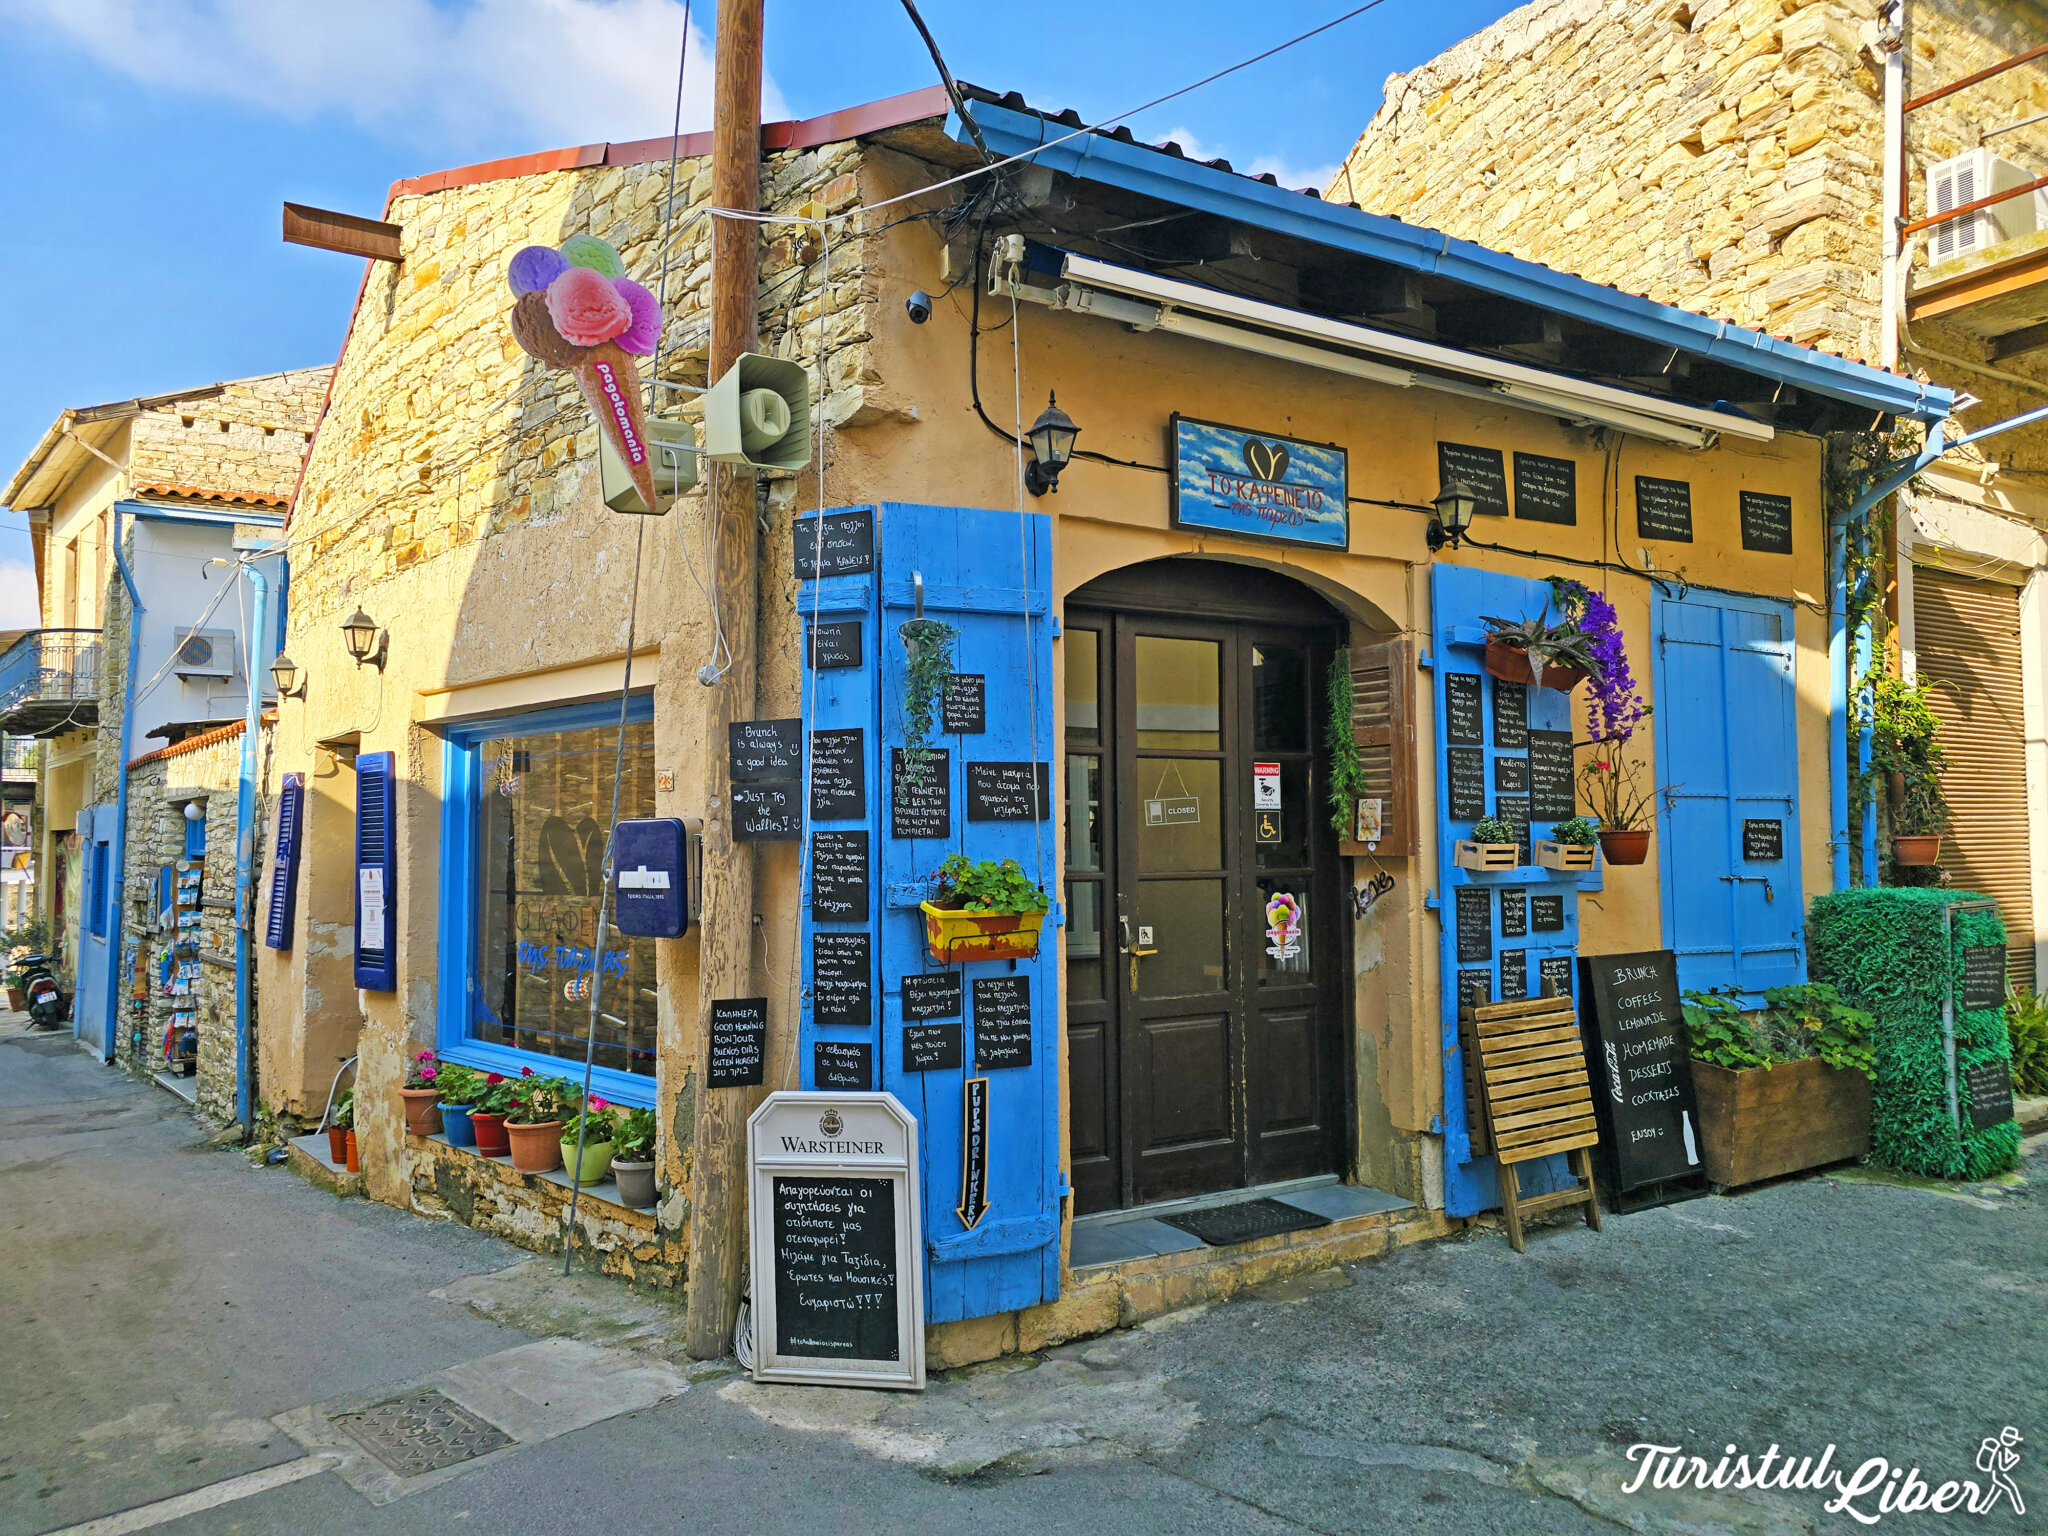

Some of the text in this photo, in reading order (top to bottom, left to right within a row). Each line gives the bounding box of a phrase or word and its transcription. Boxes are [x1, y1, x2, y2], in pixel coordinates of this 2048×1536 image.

[596, 363, 644, 463] pagotomania
[1208, 473, 1322, 510] ΤΟ ΚΑΦΕΝΕΙΟ
[1231, 502, 1252, 516] της
[798, 557, 808, 568] Το
[745, 725, 778, 738] Brunch
[737, 739, 783, 754] is always
[746, 755, 765, 771] good
[770, 756, 789, 766] idea
[1254, 766, 1279, 775] WARNING
[758, 804, 771, 816] the
[1168, 806, 1196, 815] CLOSED
[1347, 869, 1395, 920] Love
[554, 945, 628, 990] παρας
[1612, 965, 1658, 986] BRUNCH
[1617, 990, 1663, 1010] COFFEES
[713, 1021, 734, 1031] GOOD
[1618, 1011, 1667, 1031] LEMONADE
[714, 1034, 756, 1044] BONJOUR
[713, 1046, 740, 1056] BUENOS
[1622, 1034, 1676, 1061] HOMEMADE
[712, 1057, 734, 1067] GUTEN
[1628, 1060, 1672, 1083] DESSERTS
[1631, 1085, 1680, 1107] COCKTAILS
[1631, 1127, 1657, 1143] ENJOY
[779, 1182, 872, 1201] Απαγορεύονται οι
[784, 1202, 867, 1218] συζητήσεις για
[842, 1220, 862, 1233] μας
[781, 1247, 887, 1270] Μιλάμε για Ταξίδια,
[786, 1269, 895, 1287] Έρωτες και Μουσικές!
